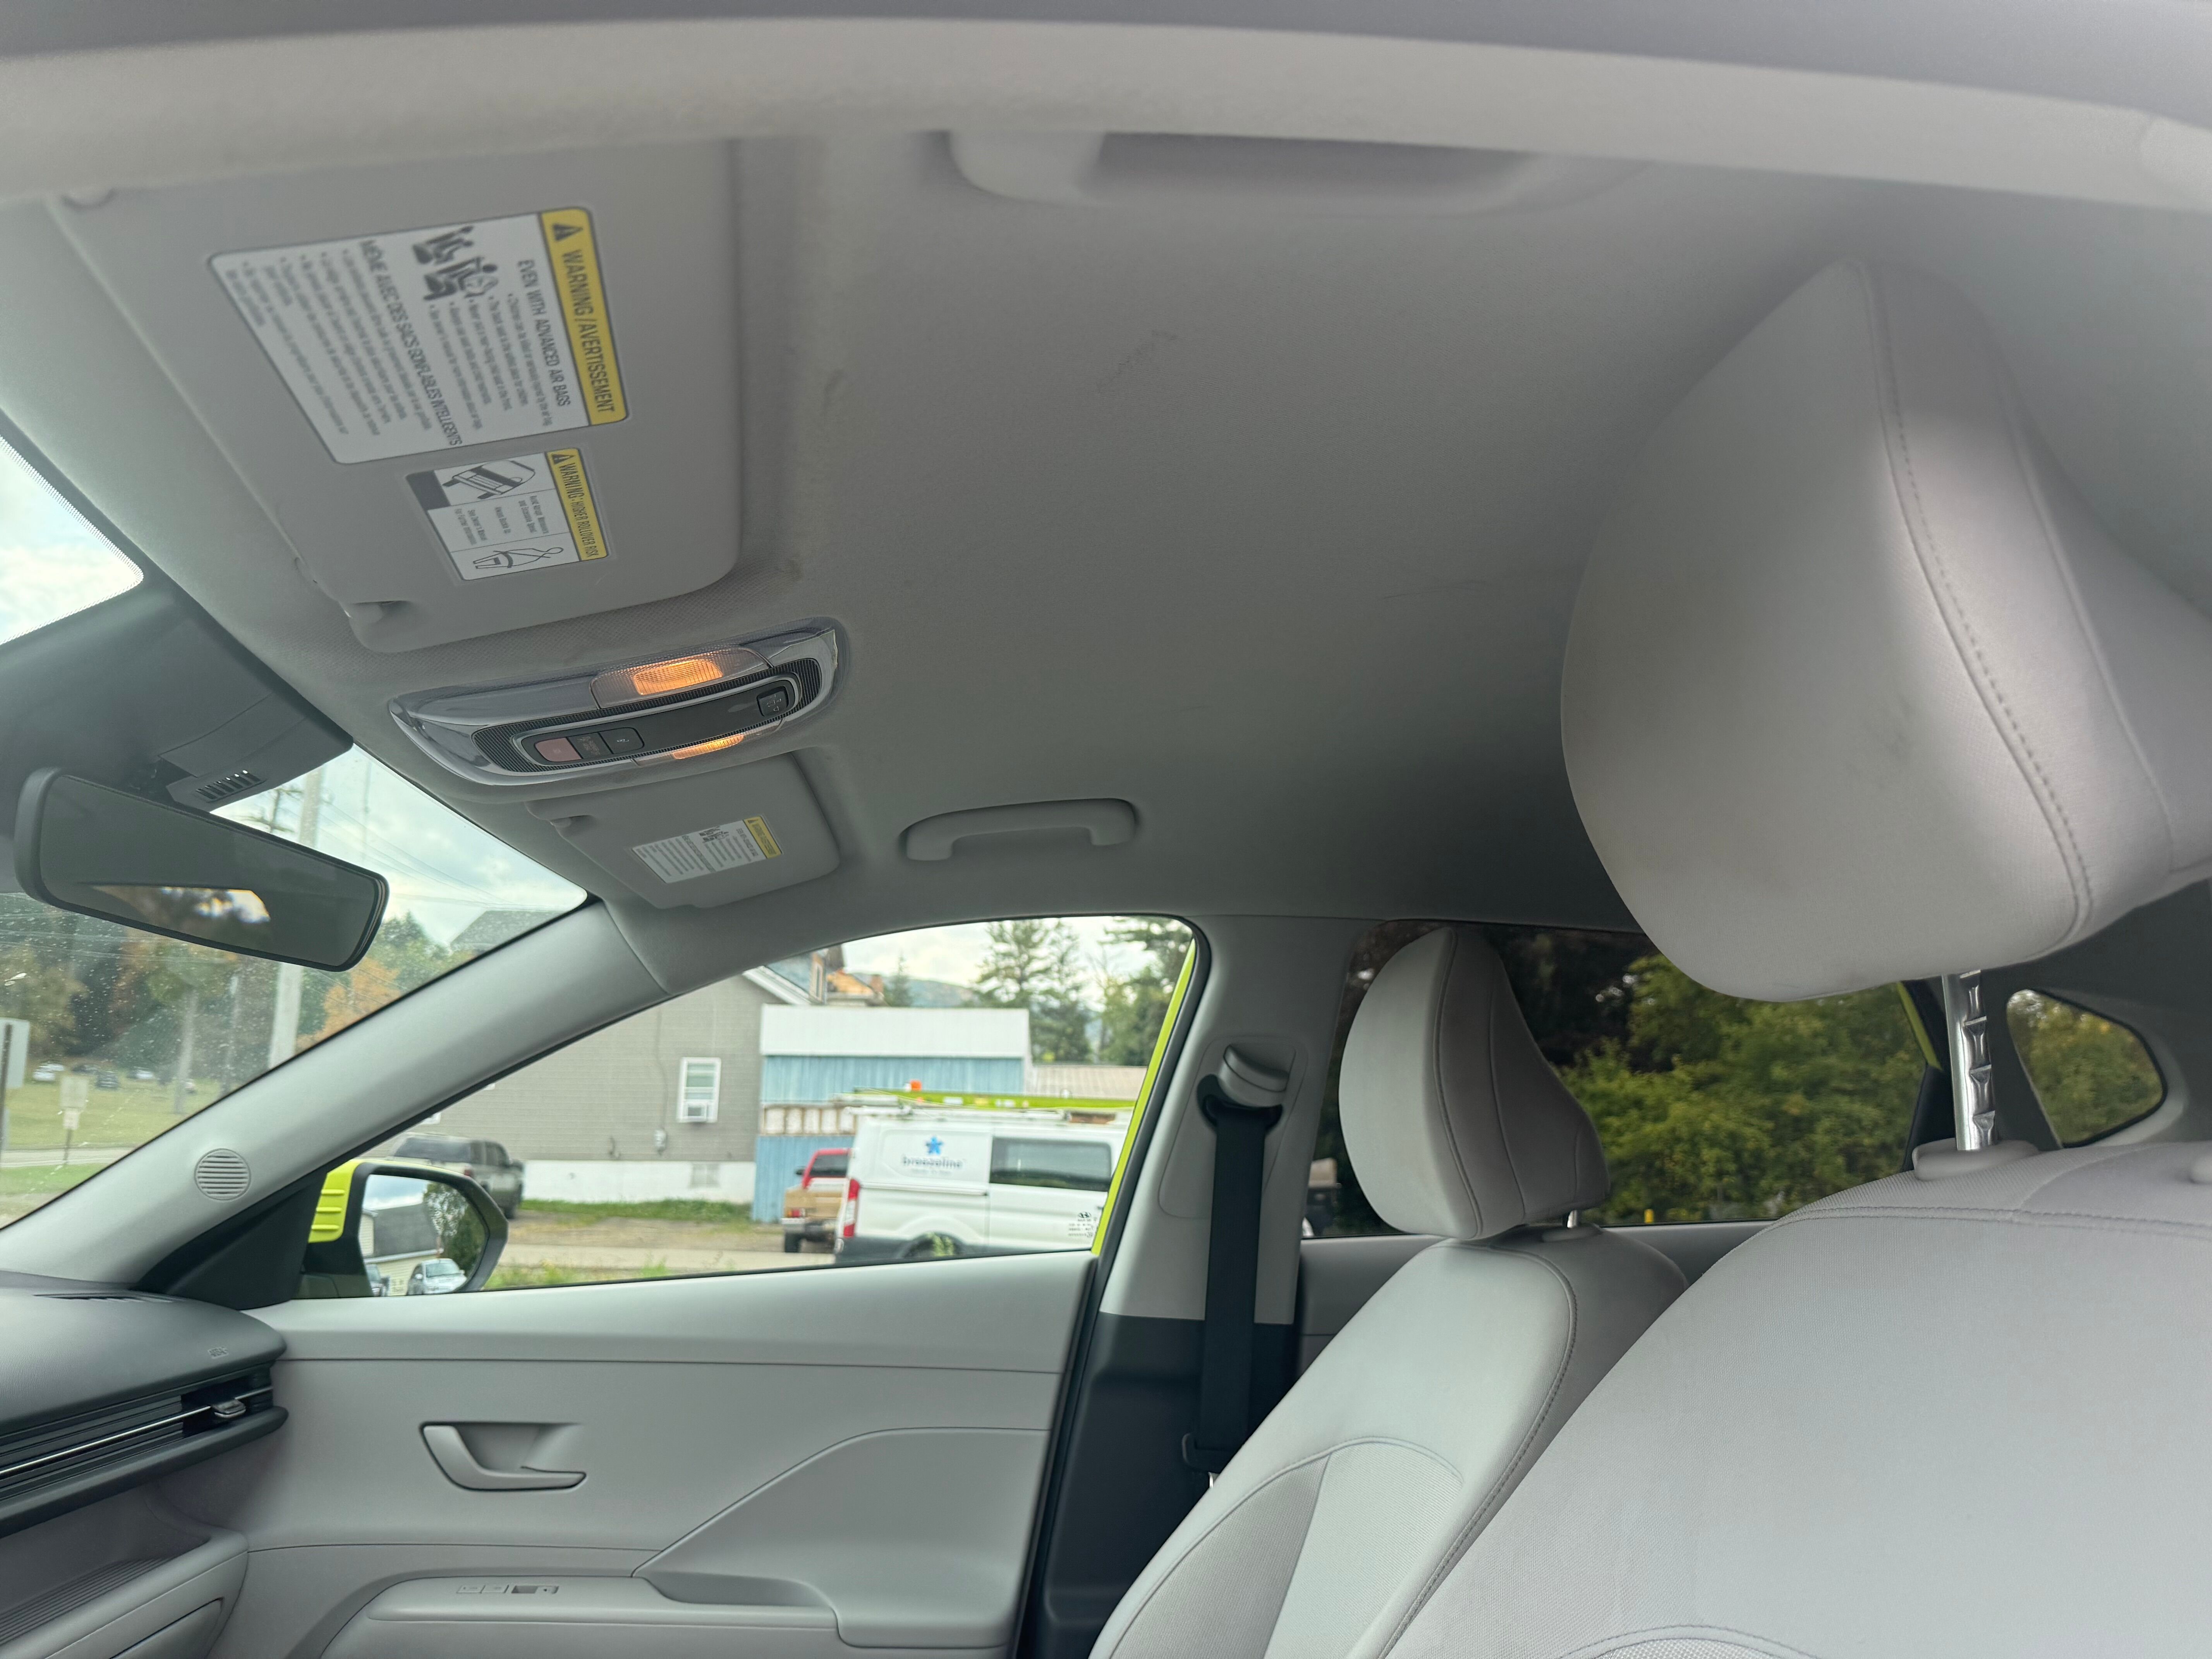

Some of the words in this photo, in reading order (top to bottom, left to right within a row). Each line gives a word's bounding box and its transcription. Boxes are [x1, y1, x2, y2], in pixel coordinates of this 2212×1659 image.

[517, 259, 540, 288] EVEN
[373, 274, 400, 301] AVEC
[385, 301, 409, 322] DES
[526, 290, 546, 315] WITH
[395, 323, 420, 348] SACS
[533, 318, 560, 367] ADVANCED
[407, 348, 443, 399] GONFLABLES
[548, 369, 564, 383] AIR
[552, 384, 571, 407] BAGS
[430, 399, 463, 446] INTELLIGENTS
[570, 501, 588, 520] HIGHER
[576, 520, 596, 546] ROLLOVER
[584, 545, 599, 557] RISK
